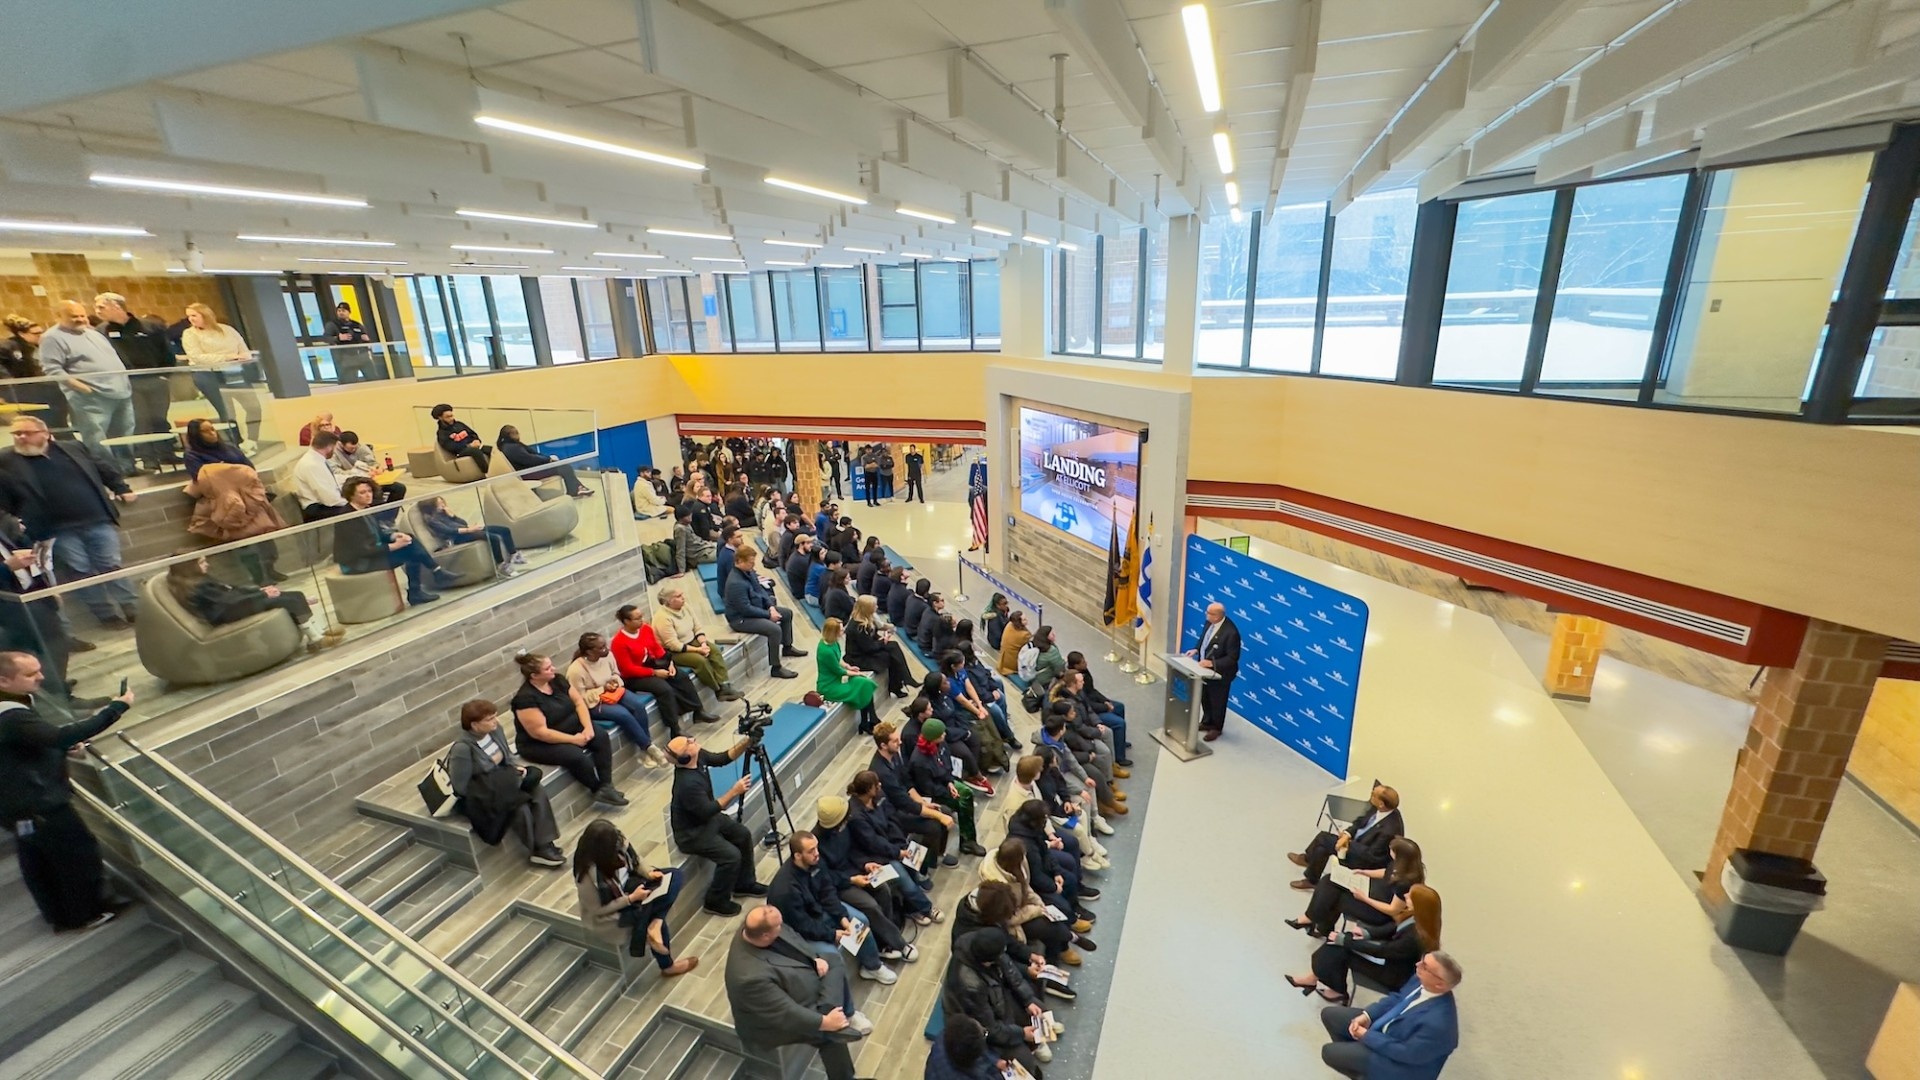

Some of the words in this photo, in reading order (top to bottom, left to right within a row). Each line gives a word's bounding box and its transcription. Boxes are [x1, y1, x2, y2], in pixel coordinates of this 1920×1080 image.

[1068, 449, 1079, 460] THE
[1043, 451, 1106, 488] LANDING
[1055, 474, 1063, 482] AT
[1063, 476, 1090, 492] ELLICOTT
